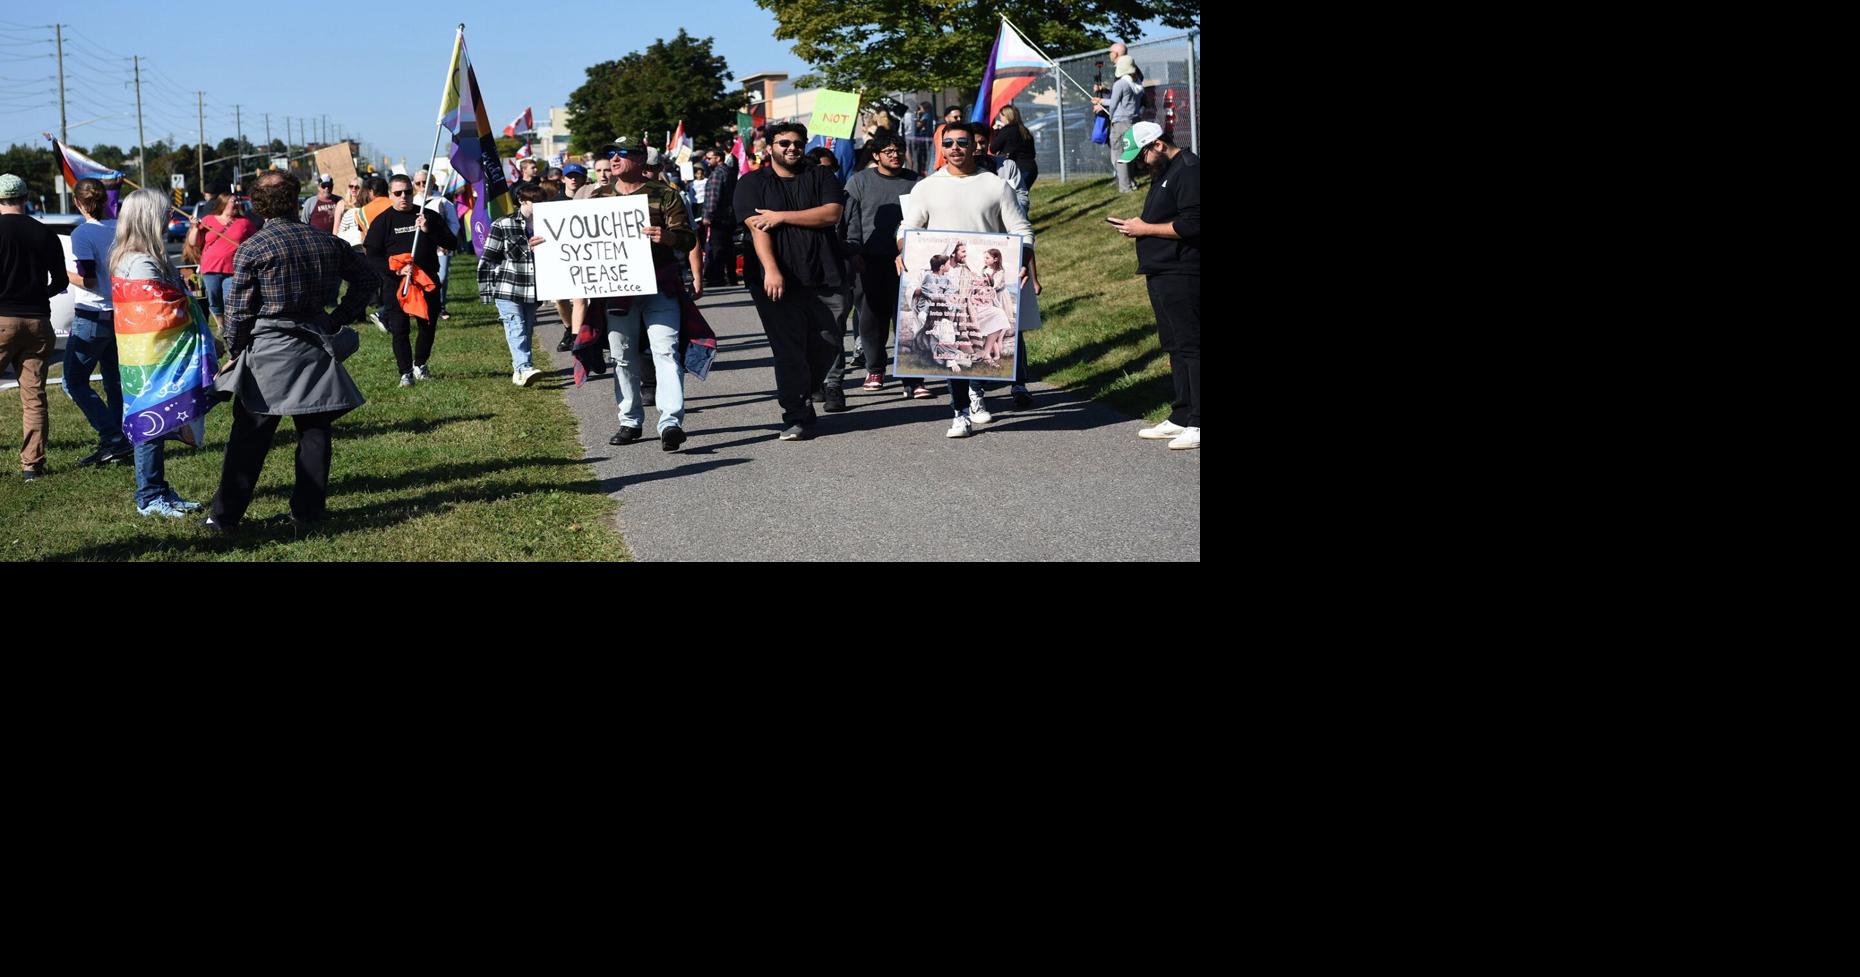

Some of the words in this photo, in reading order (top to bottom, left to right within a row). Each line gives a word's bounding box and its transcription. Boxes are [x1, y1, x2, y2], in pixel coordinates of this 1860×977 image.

[822, 112, 850, 124] NOT
[543, 209, 650, 241] VOUCHER
[560, 240, 629, 262] SYSTEM
[569, 264, 629, 286] PLEASE
[583, 284, 608, 295] Mr.
[608, 282, 643, 293] Lecce
